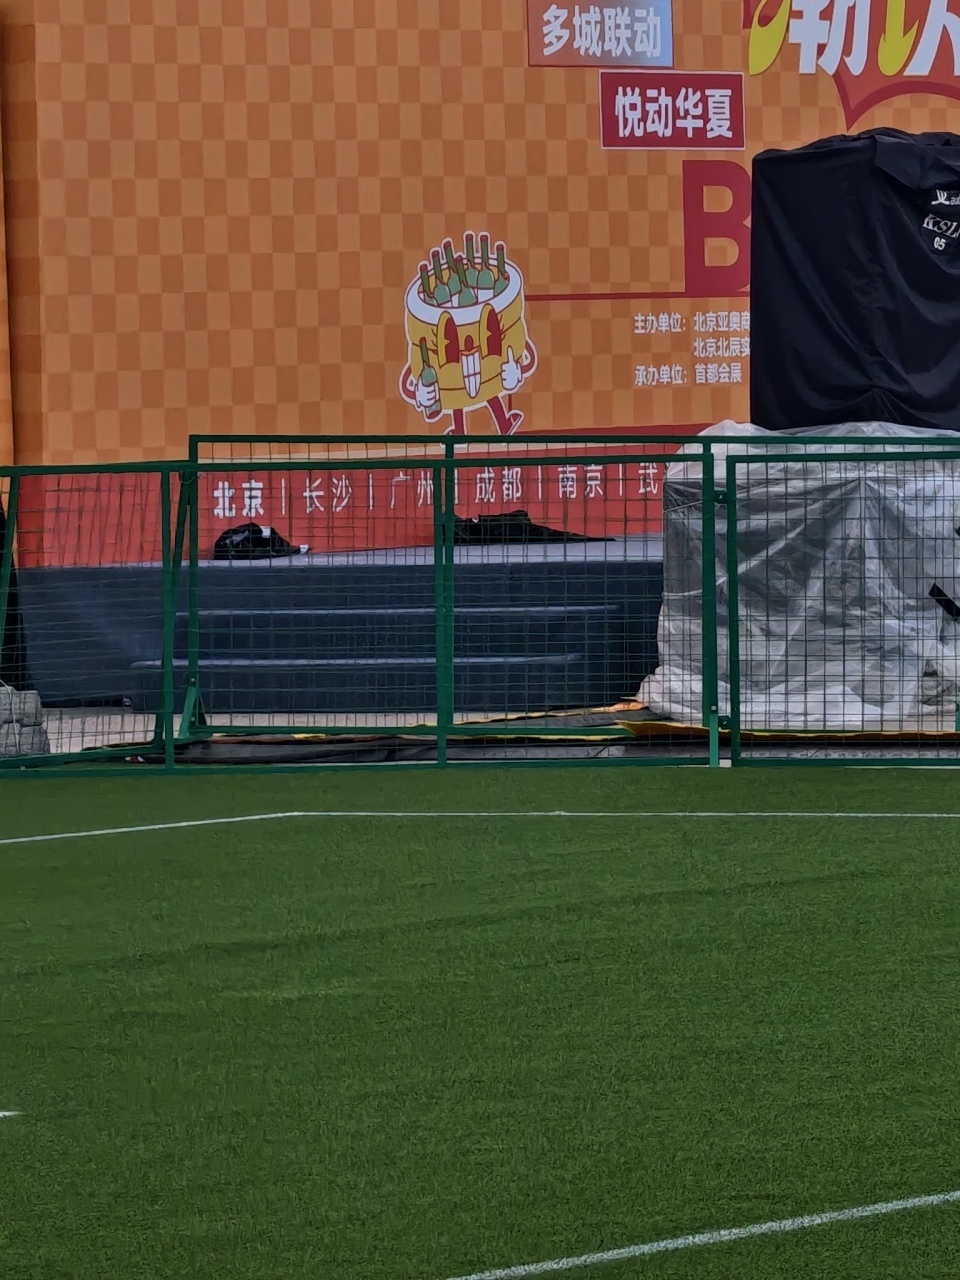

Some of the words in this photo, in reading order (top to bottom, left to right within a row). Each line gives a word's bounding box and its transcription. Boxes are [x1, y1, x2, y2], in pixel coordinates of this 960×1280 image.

[542, 4, 662, 58] 多城联动
[615, 86, 733, 139] 悦动华夏
[213, 478, 265, 519] 北京
[302, 474, 352, 514] 长沙
[390, 470, 434, 509] 广州
[475, 466, 522, 504] 成都
[557, 464, 604, 499] 南京
[637, 462, 671, 496] 武
